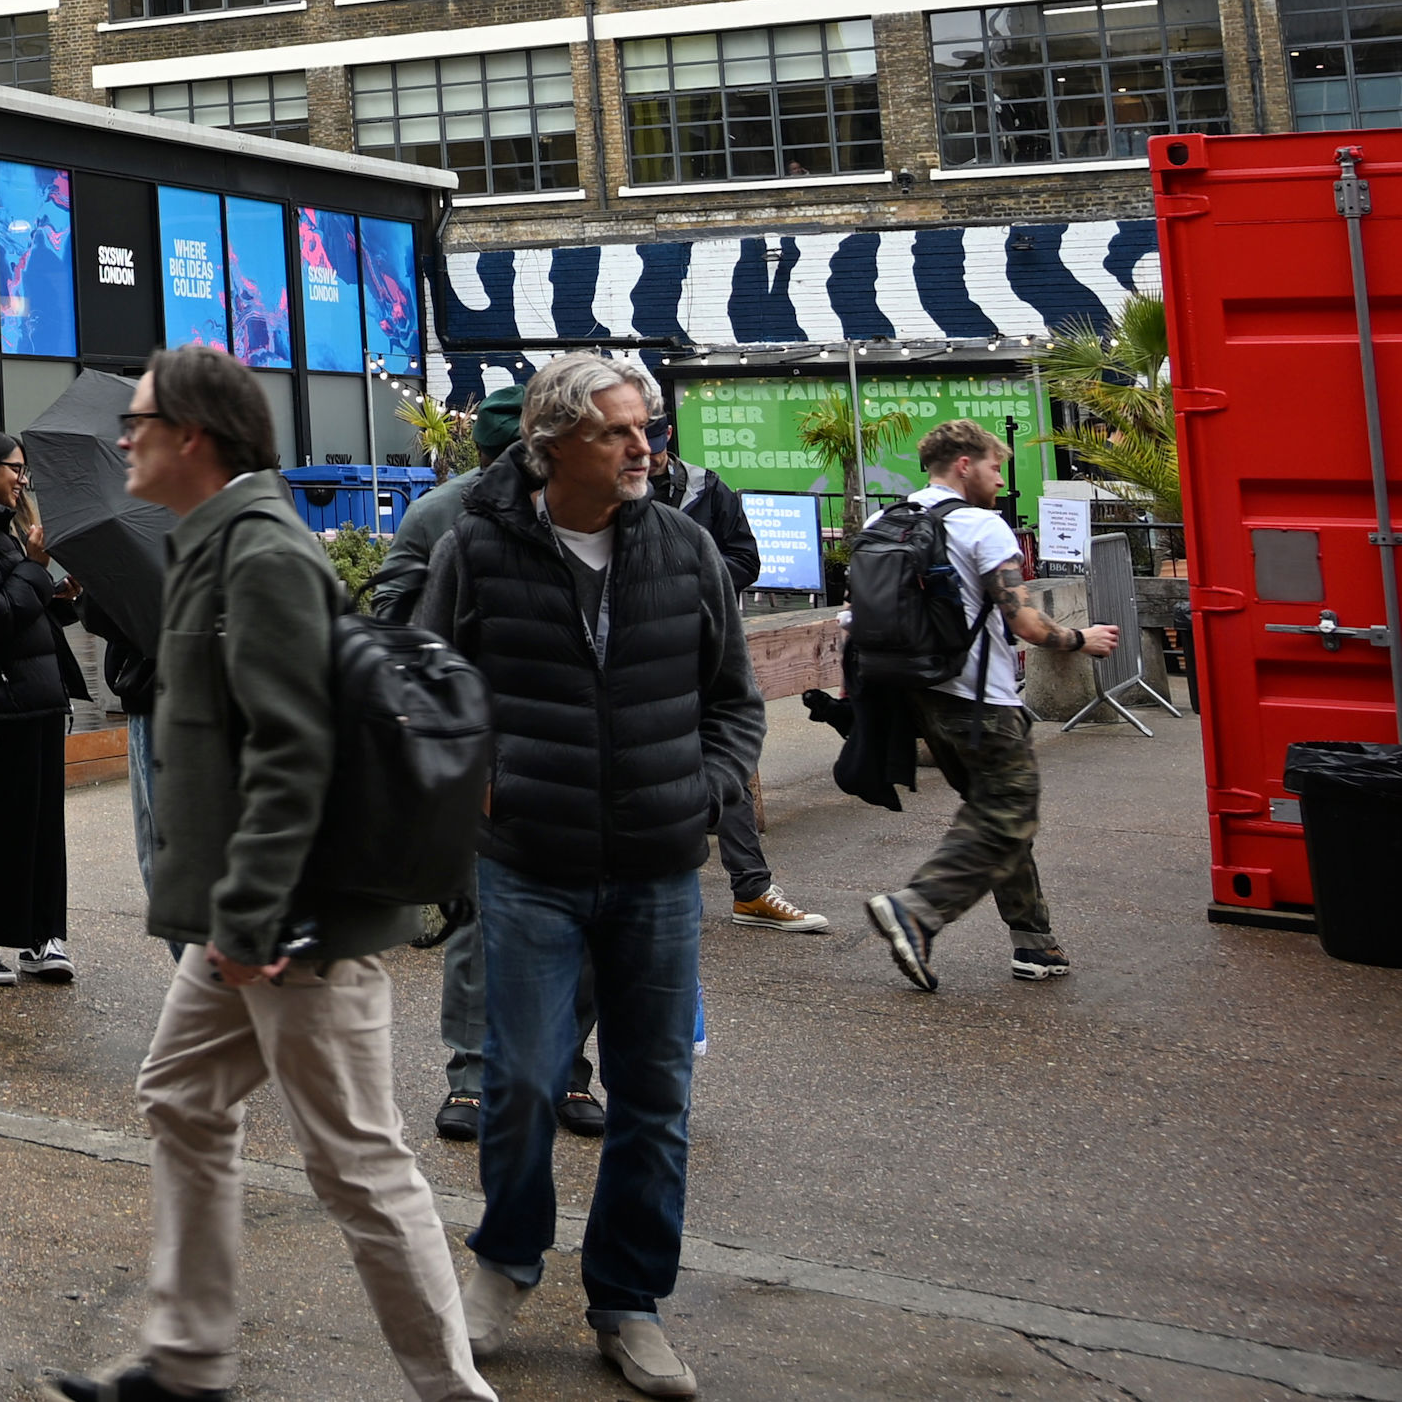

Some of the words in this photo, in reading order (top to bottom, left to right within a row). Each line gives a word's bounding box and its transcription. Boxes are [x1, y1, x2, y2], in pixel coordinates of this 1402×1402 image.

[98, 245, 125, 267] SXSW
[173, 238, 207, 261] WHERE
[98, 264, 135, 287] LONDON
[169, 257, 185, 278] BIG
[186, 259, 214, 281] IDEAS
[307, 265, 332, 285] SXSW
[173, 277, 212, 300] COLLIDE
[309, 284, 339, 303] LONDON
[699, 381, 847, 402] COCKTAILS
[862, 381, 943, 398] GREAT
[949, 380, 1030, 397] MUSIC
[700, 406, 765, 424] BEER
[864, 401, 937, 418] GOOD
[954, 400, 1031, 418] TIMES
[702, 427, 757, 449] BBQ
[703, 450, 824, 469] BURGERS
[746, 508, 801, 518] OUTSIDE
[759, 529, 807, 539] DRINKS
